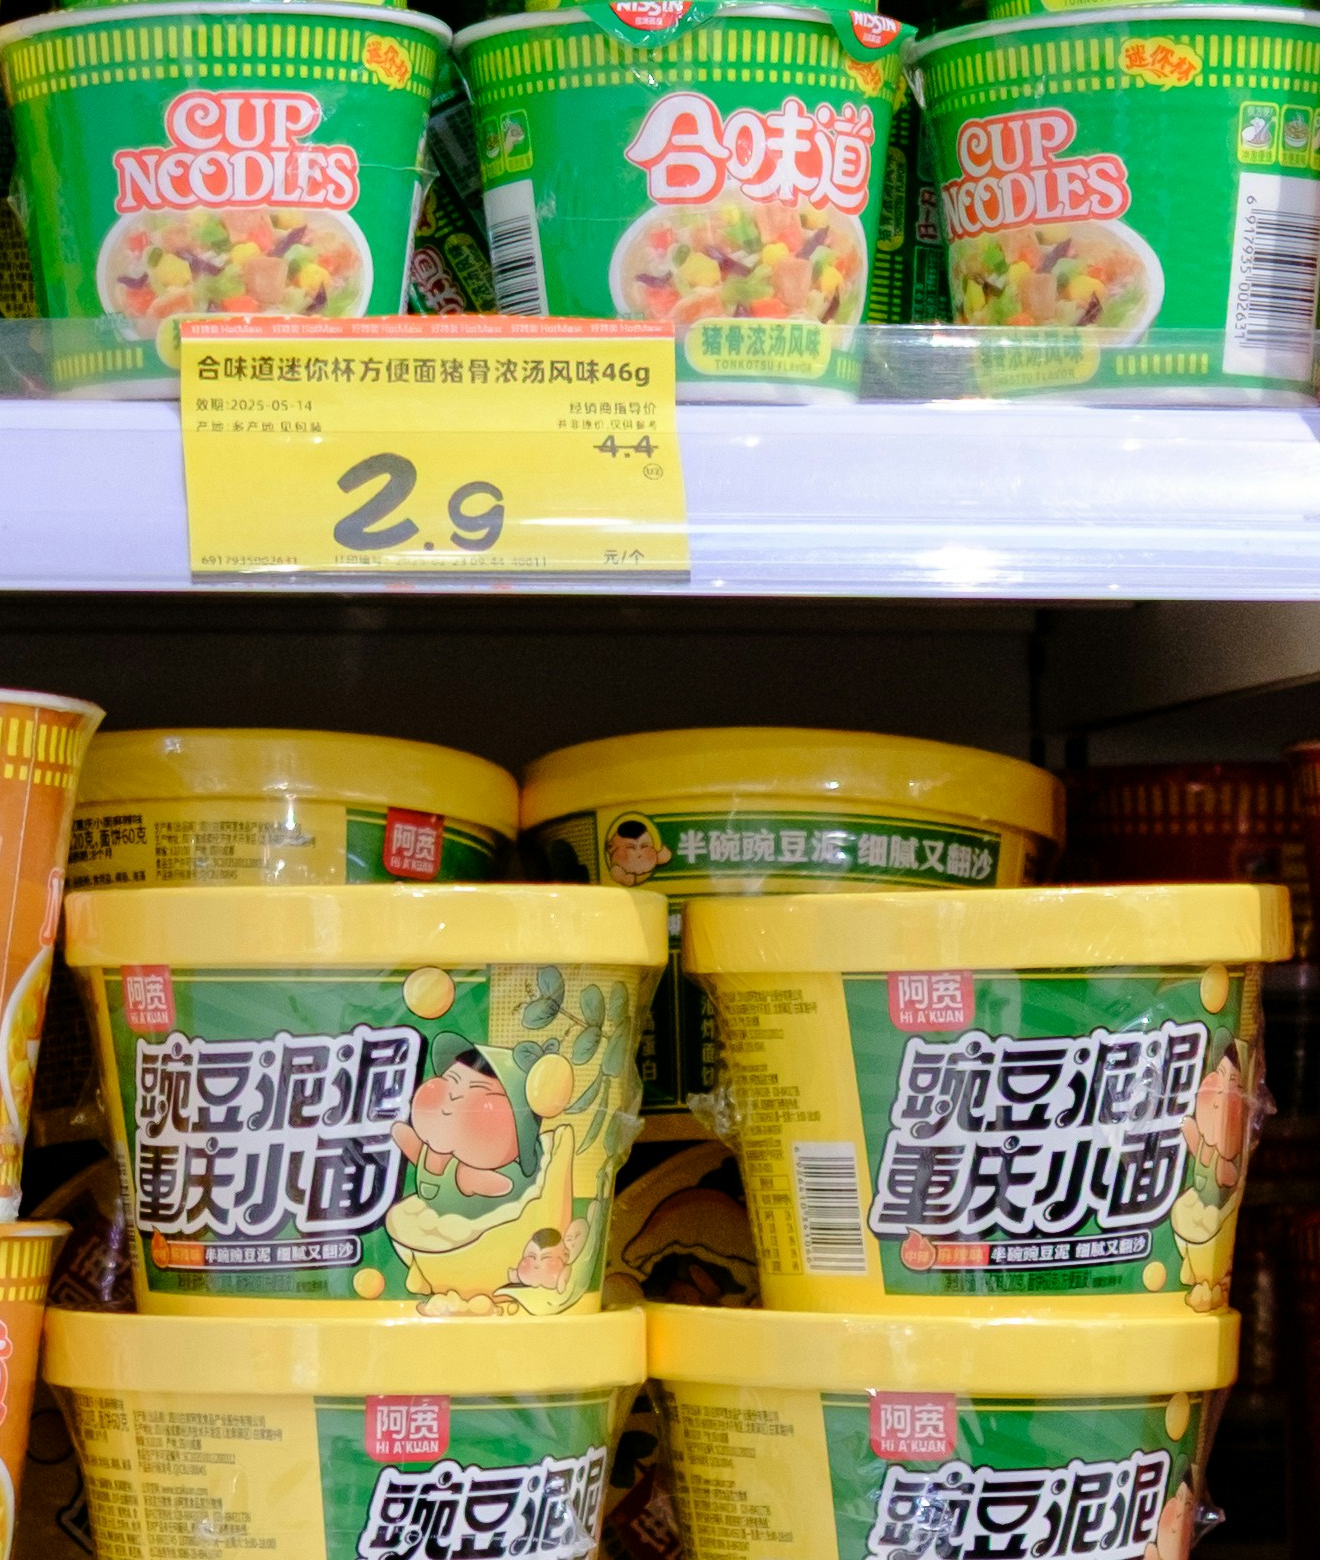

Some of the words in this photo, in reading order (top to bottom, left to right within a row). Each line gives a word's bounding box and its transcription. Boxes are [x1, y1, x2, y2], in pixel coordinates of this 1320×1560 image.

[167, 90, 324, 150] CUP
[114, 146, 360, 211] NOODLES
[626, 93, 874, 214] 合味道
[196, 356, 651, 388] 合味道迷你杯方便面猪骨浓汤风味46g
[196, 397, 313, 413] 效期:2025-05-14
[593, 434, 659, 459] 4.4
[332, 452, 505, 552] 2.9
[603, 549, 645, 566] 元/个
[677, 830, 842, 866] 半碗豌豆泥
[857, 832, 994, 878] 细腻又翻沙
[139, 1029, 419, 1141] 豌豆泥泥
[137, 1139, 403, 1230] 重庆小面
[880, 1404, 953, 1438] 阿宽
